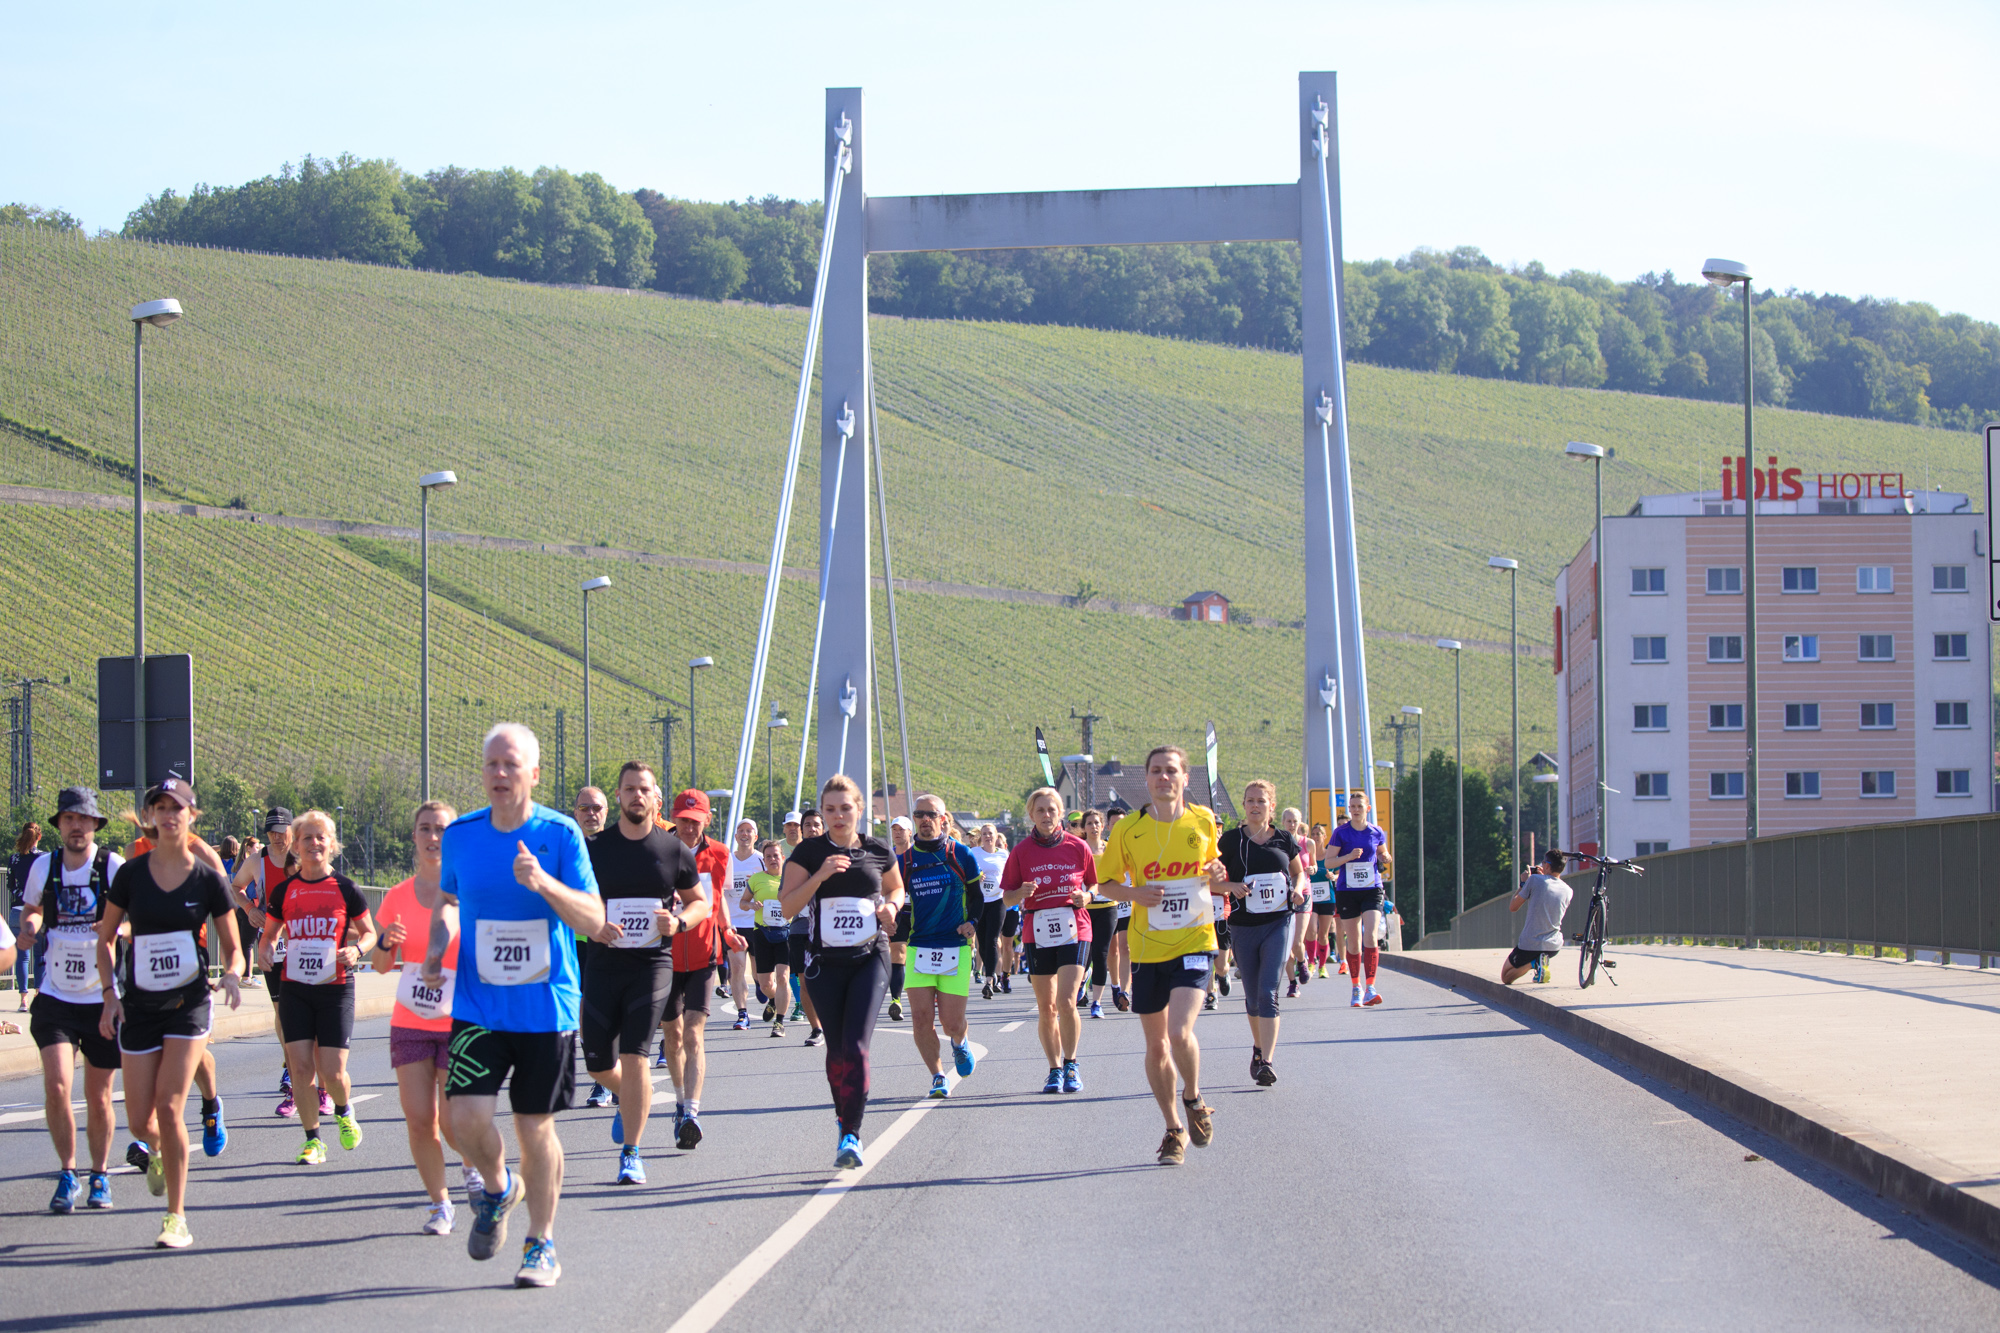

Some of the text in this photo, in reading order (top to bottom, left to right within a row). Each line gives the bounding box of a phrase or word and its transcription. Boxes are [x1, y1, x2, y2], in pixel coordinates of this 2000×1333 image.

[1722, 456, 1914, 501] ibis HOTEL
[922, 873, 951, 882] HANNOVER
[1353, 871, 1368, 879] 1953
[913, 880, 940, 889] MARATHON
[1259, 888, 1274, 899] 101
[1162, 898, 1189, 913] 2577
[770, 910, 782, 918] 153
[57, 924, 94, 934] ARATO
[286, 915, 338, 938] WÜRZ
[620, 917, 649, 931] 2222
[833, 916, 863, 929] 2223
[1048, 922, 1061, 934] 33
[494, 945, 530, 962] 2201
[931, 951, 943, 962] 32
[65, 959, 85, 973] 278
[150, 954, 180, 972] 2107
[299, 957, 323, 970] 2124
[411, 985, 443, 1003] 1463
